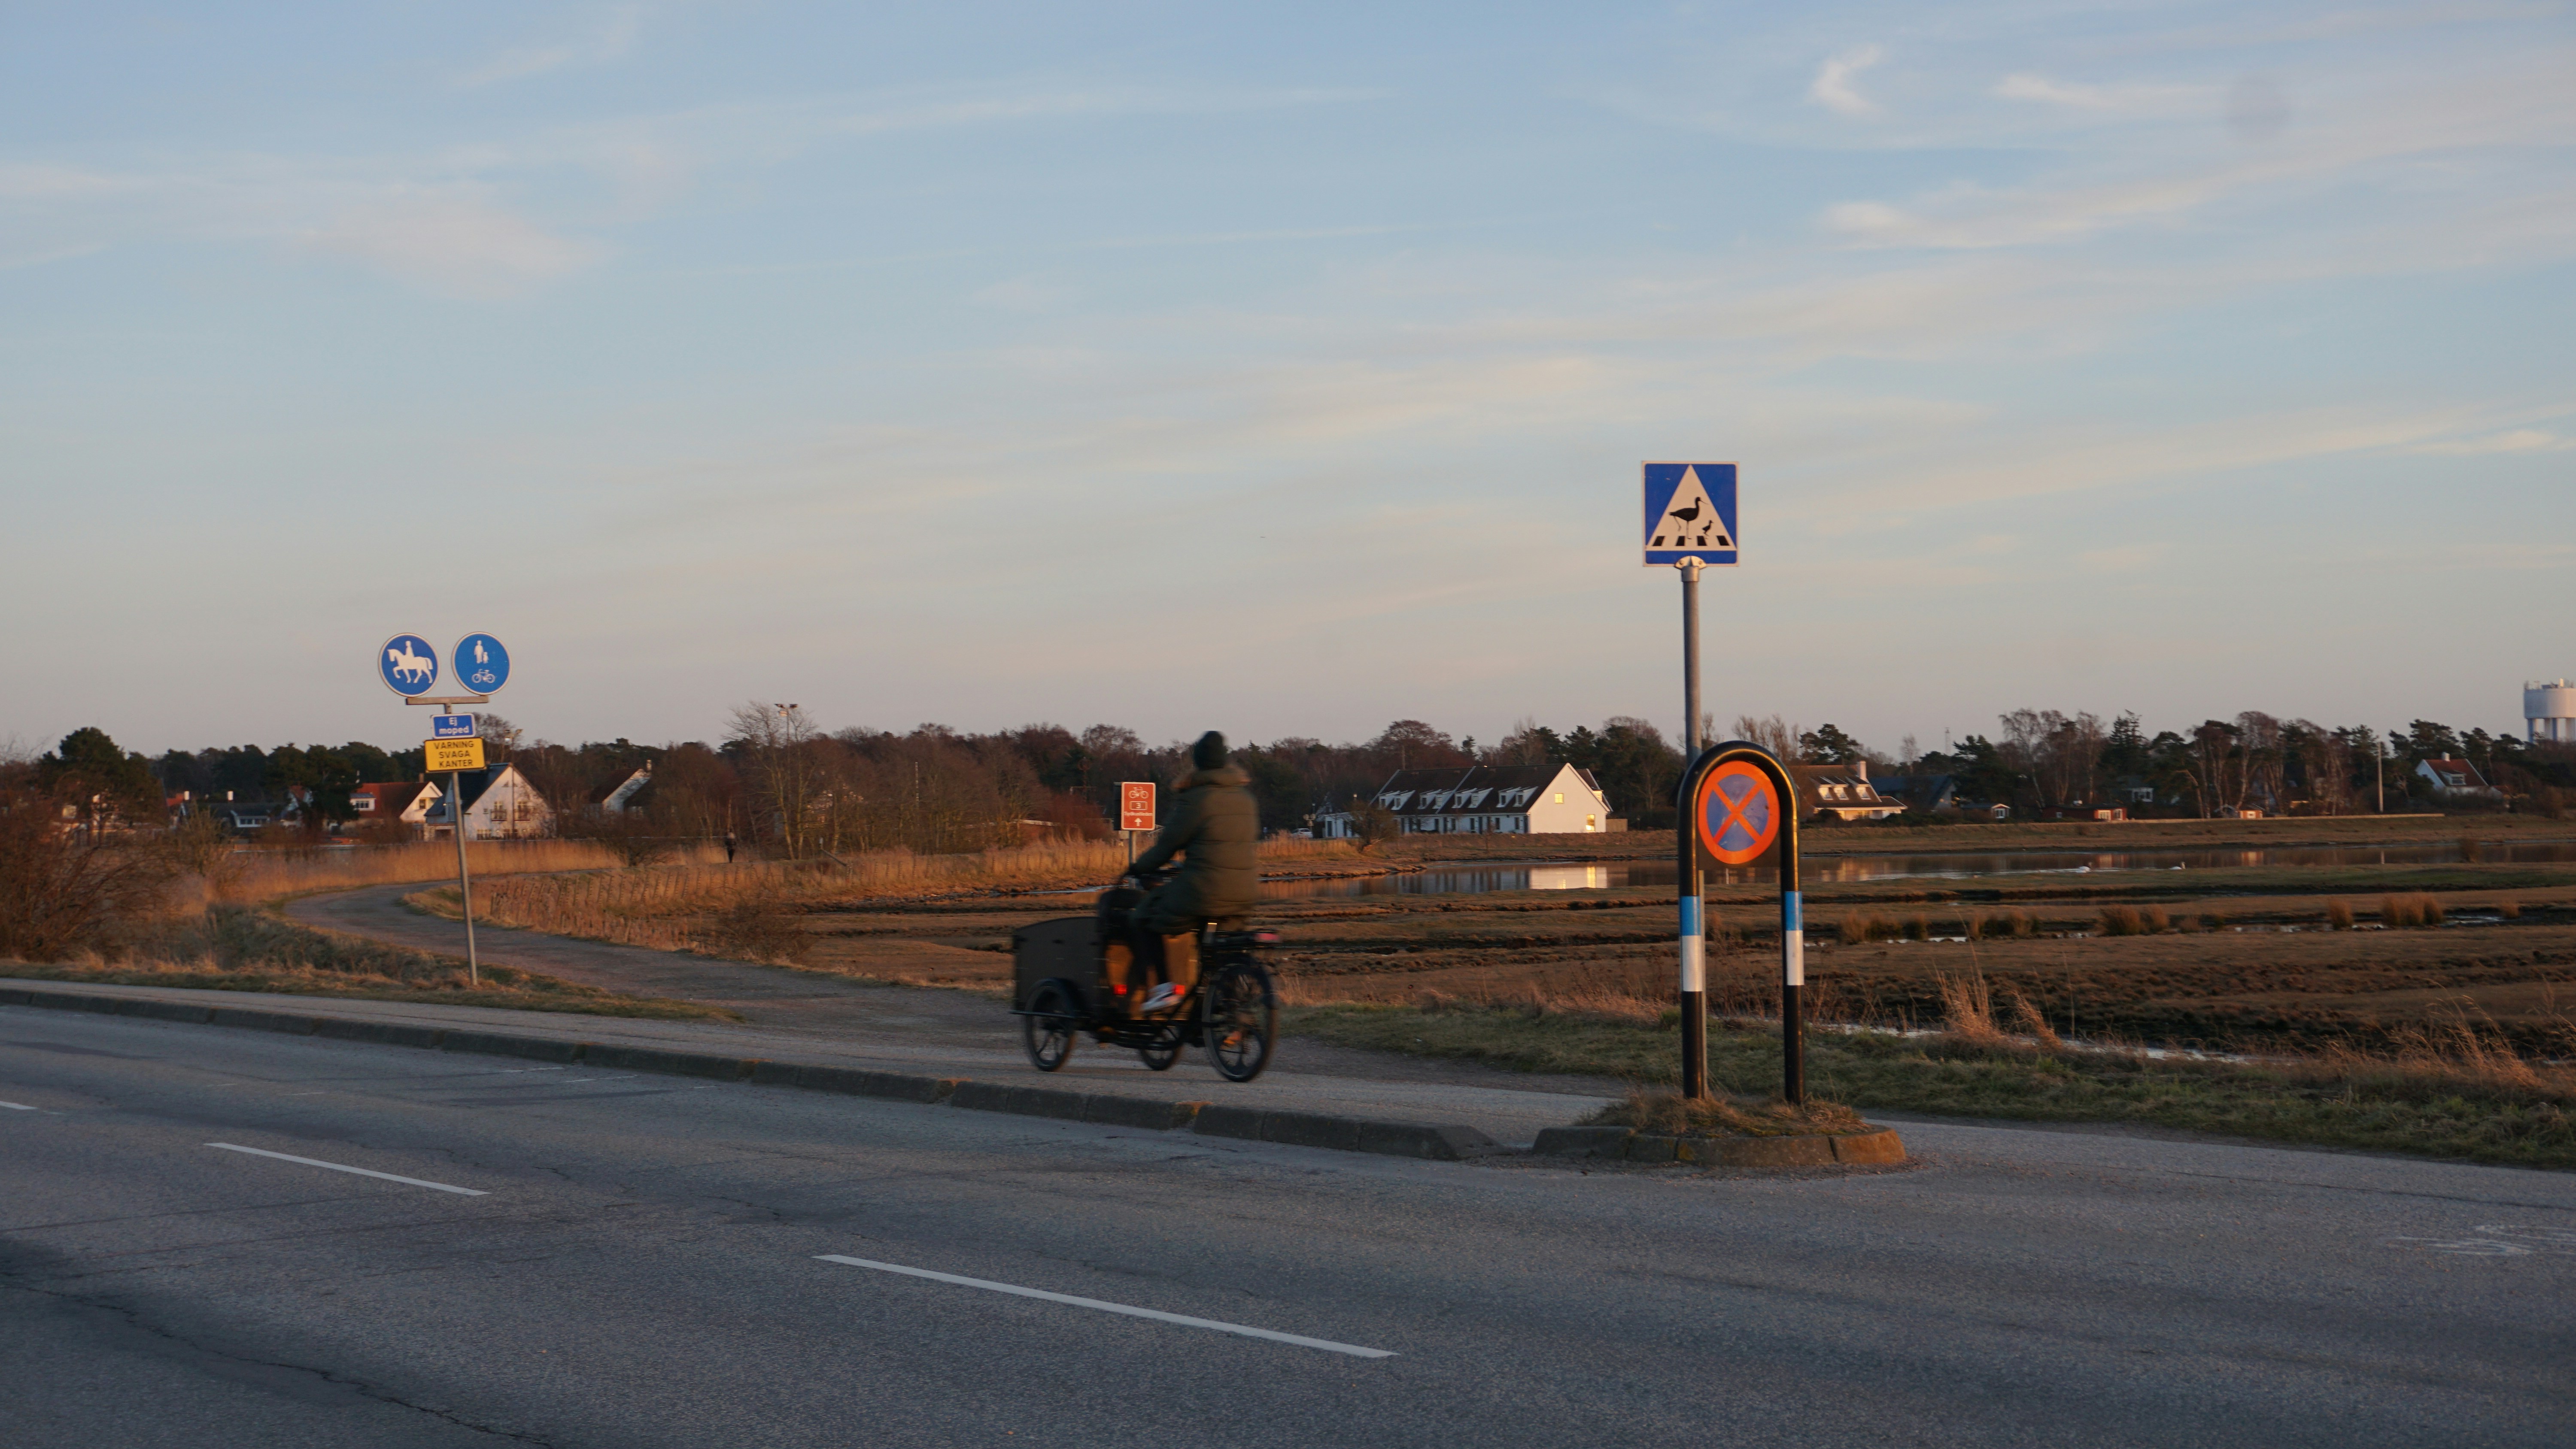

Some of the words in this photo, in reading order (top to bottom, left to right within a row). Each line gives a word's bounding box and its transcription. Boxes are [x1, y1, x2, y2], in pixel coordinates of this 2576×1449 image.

[449, 717, 457, 726] Ej
[439, 725, 469, 735] moped
[434, 740, 474, 749] VARNING
[439, 759, 473, 768] KANTER
